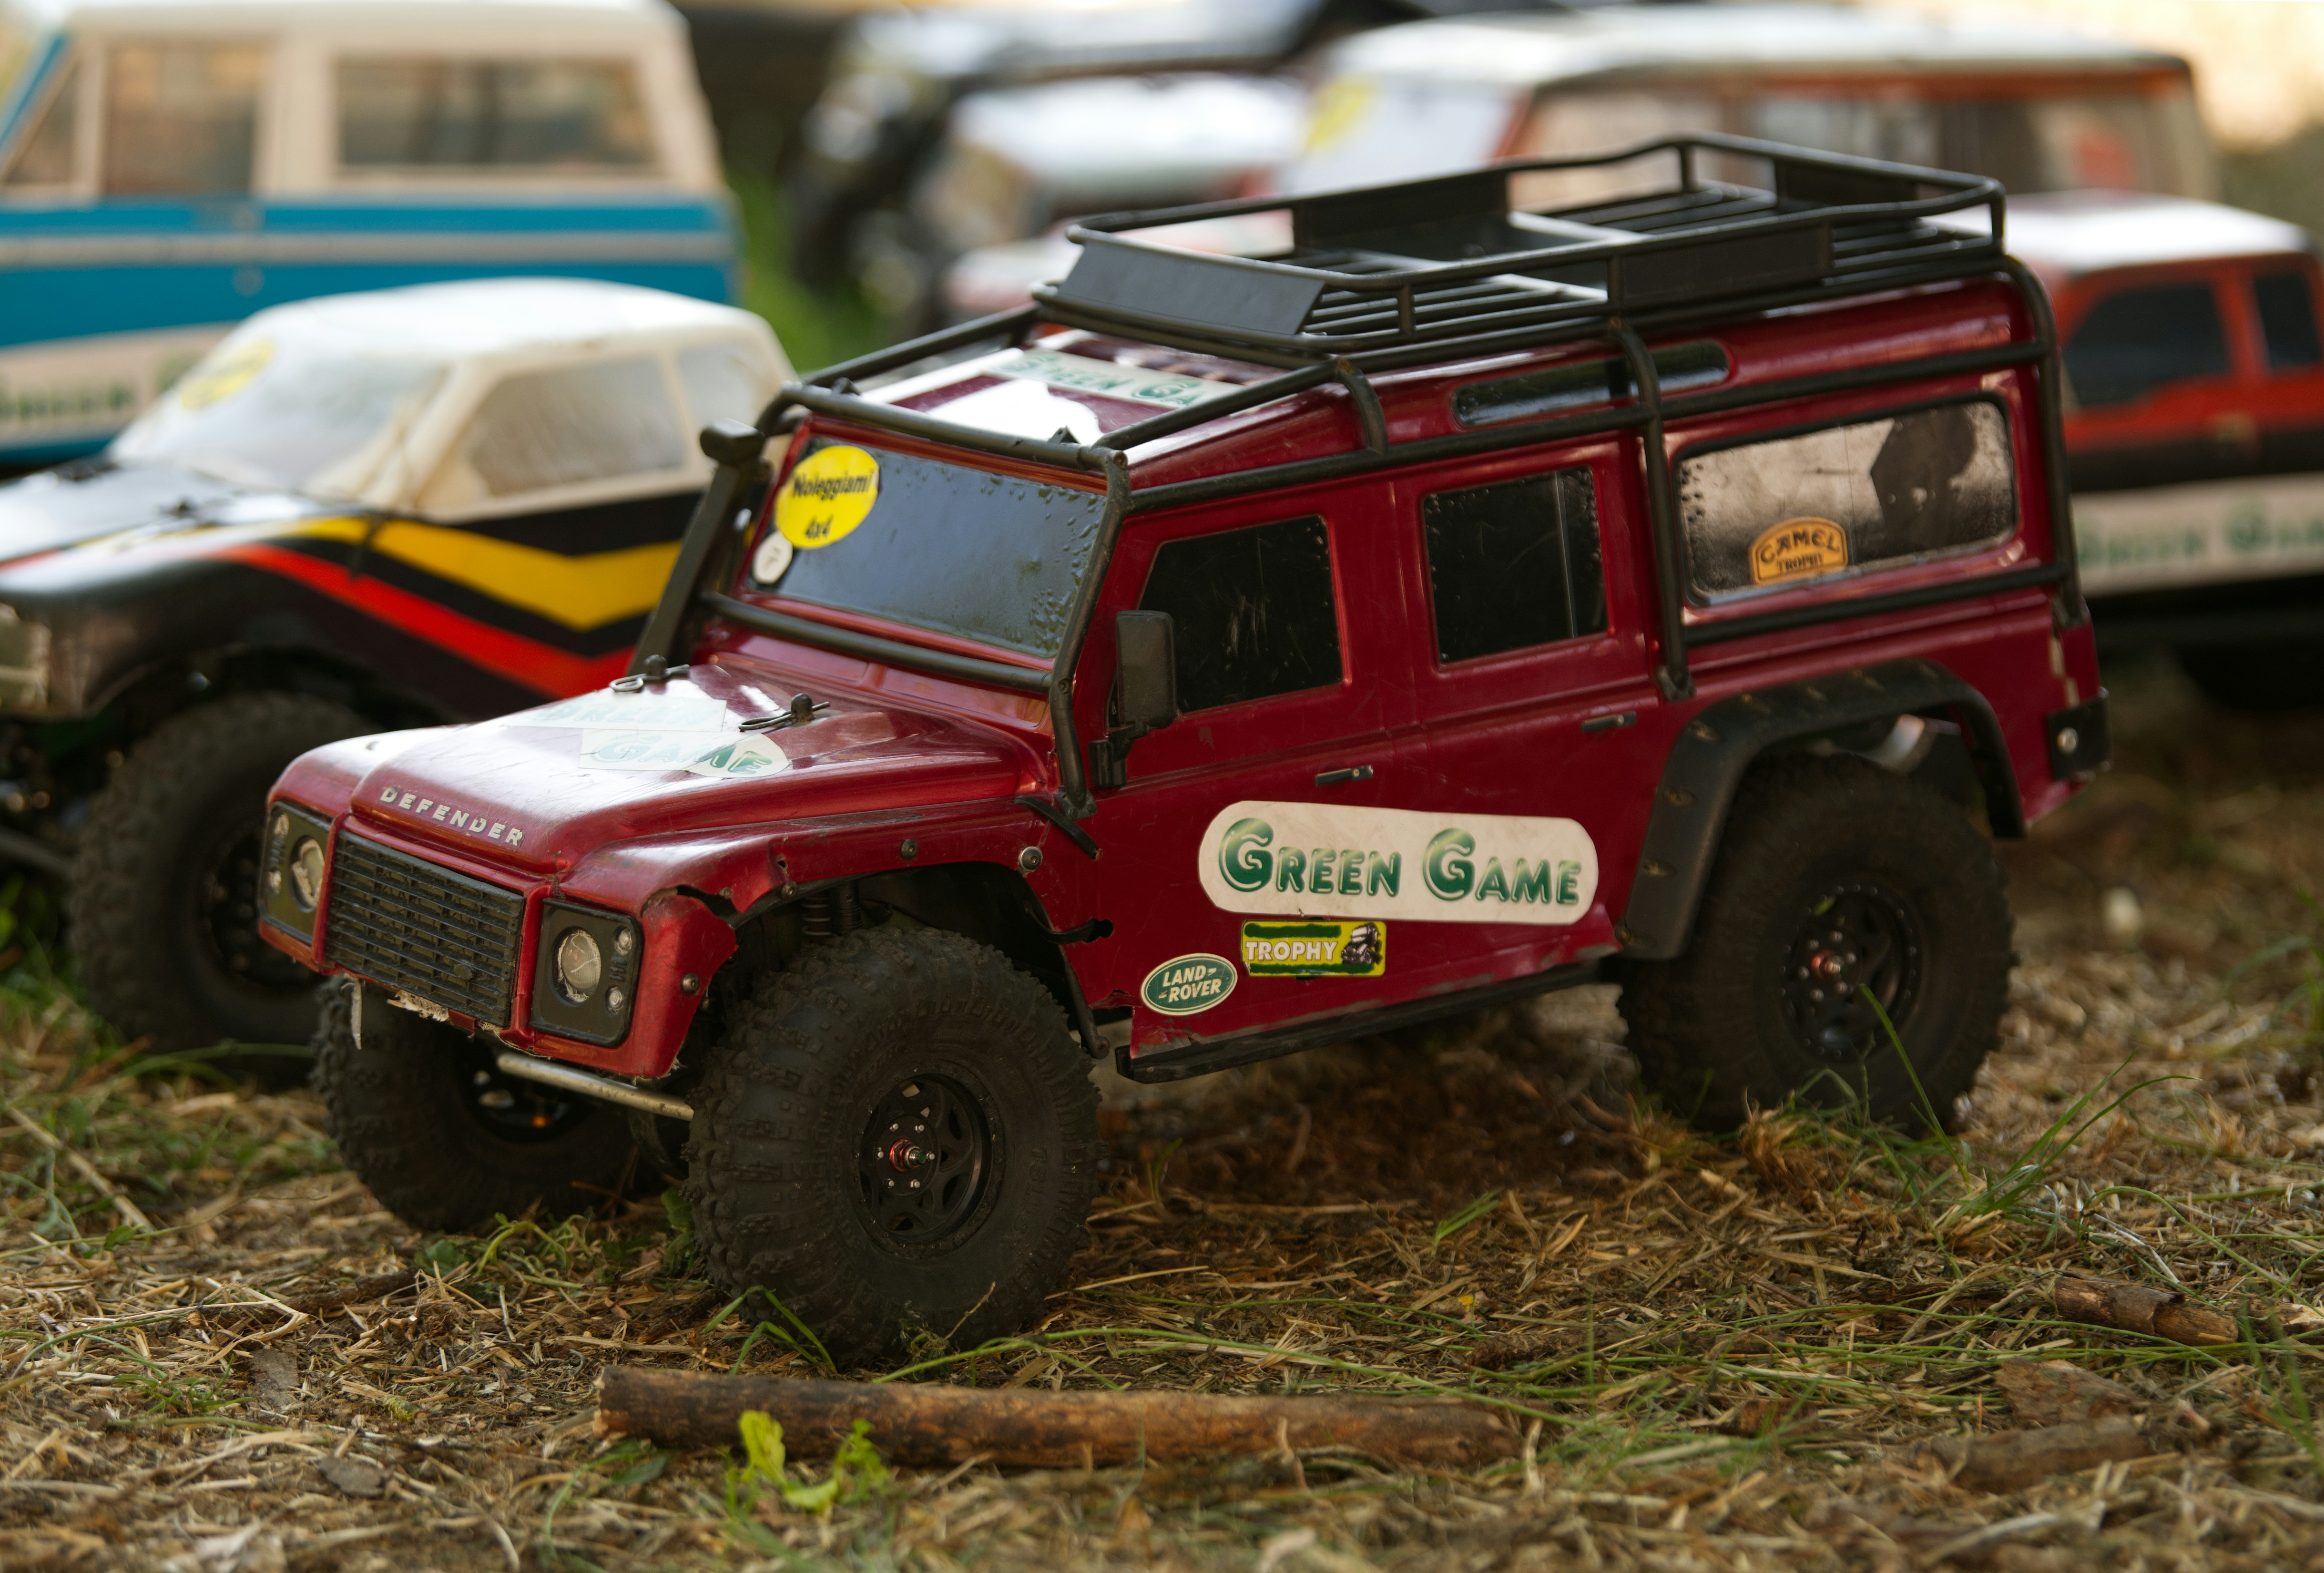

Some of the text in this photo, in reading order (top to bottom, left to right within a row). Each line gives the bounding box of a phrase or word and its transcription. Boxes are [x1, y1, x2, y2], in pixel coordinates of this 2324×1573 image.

[793, 469, 875, 500] Noleggiami
[805, 514, 834, 539] 4x4
[1760, 528, 1840, 563] CAMEL
[1777, 551, 1824, 573] TROPHY
[589, 732, 773, 775] GAME
[380, 786, 523, 847] DEFENDER
[1218, 817, 1581, 906] GREEN GAME
[1245, 940, 1338, 961] TROPHY
